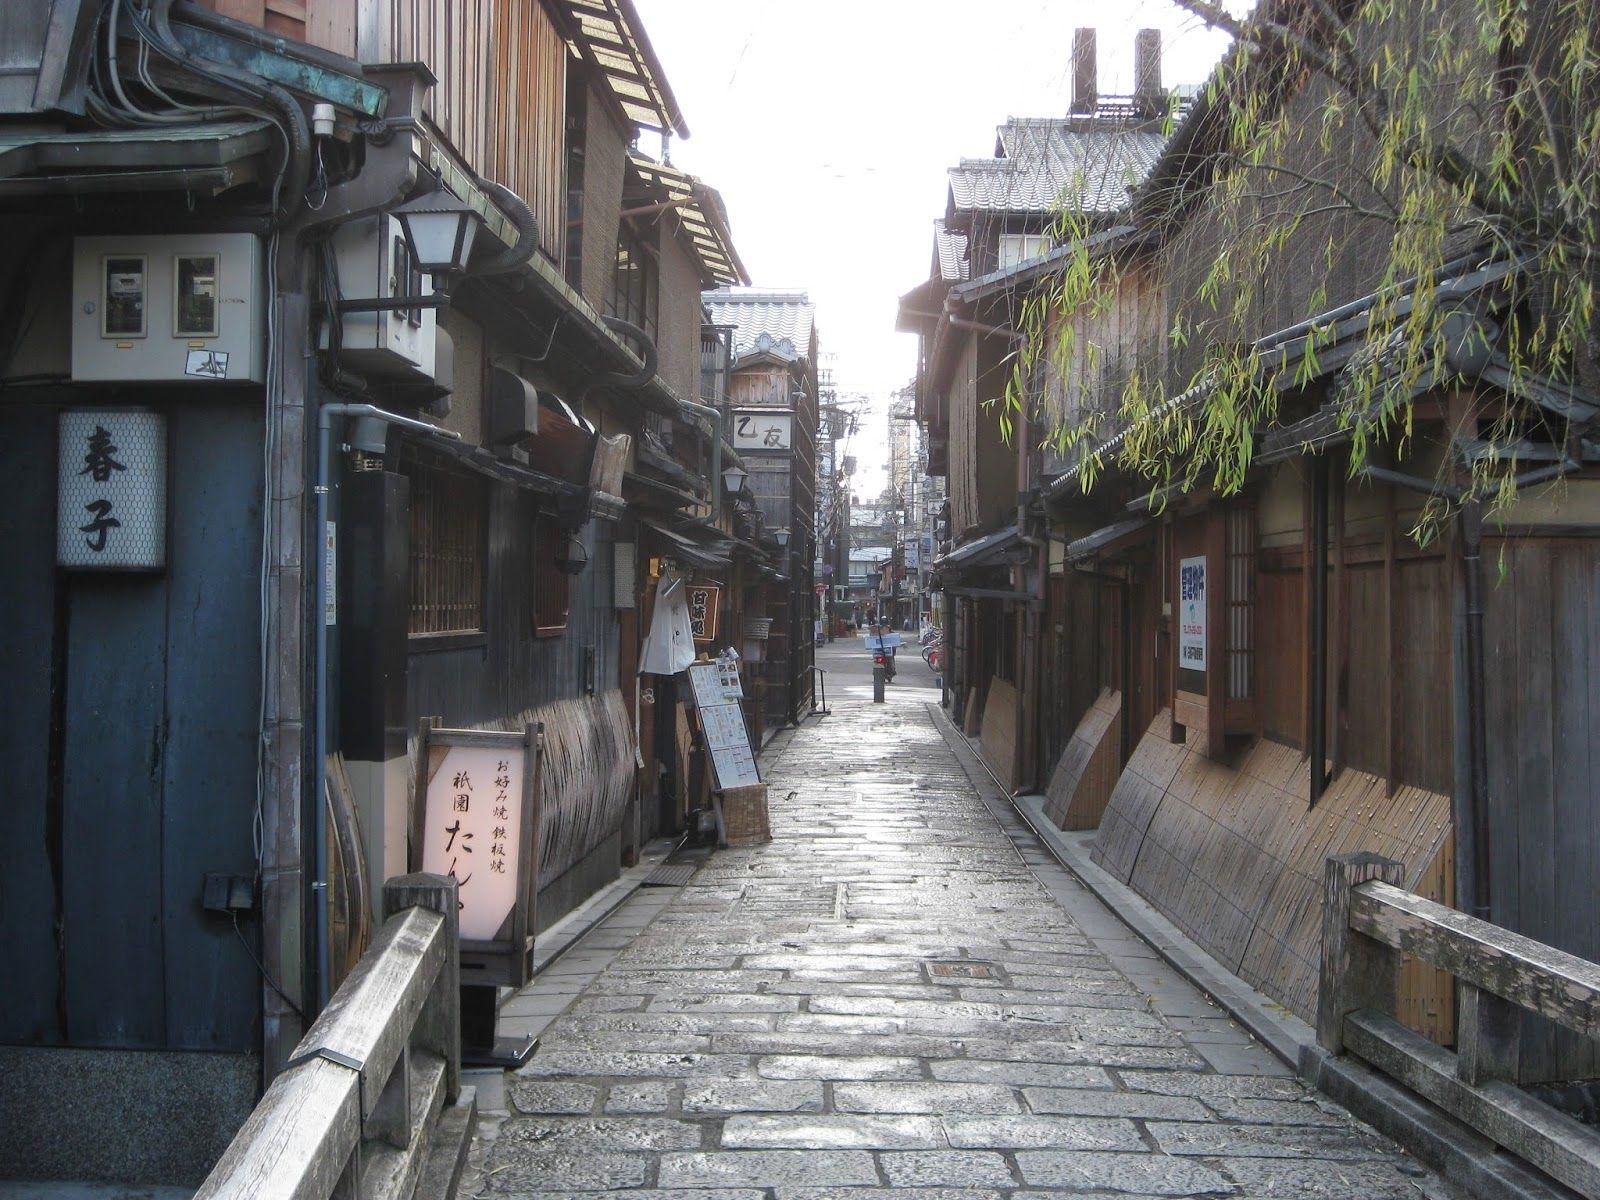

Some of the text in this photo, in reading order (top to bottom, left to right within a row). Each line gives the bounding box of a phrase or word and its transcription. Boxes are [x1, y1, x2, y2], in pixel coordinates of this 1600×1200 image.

[78, 425, 127, 552] 春子
[691, 590, 709, 636] 甘味処
[445, 770, 474, 910] 祇園たん
